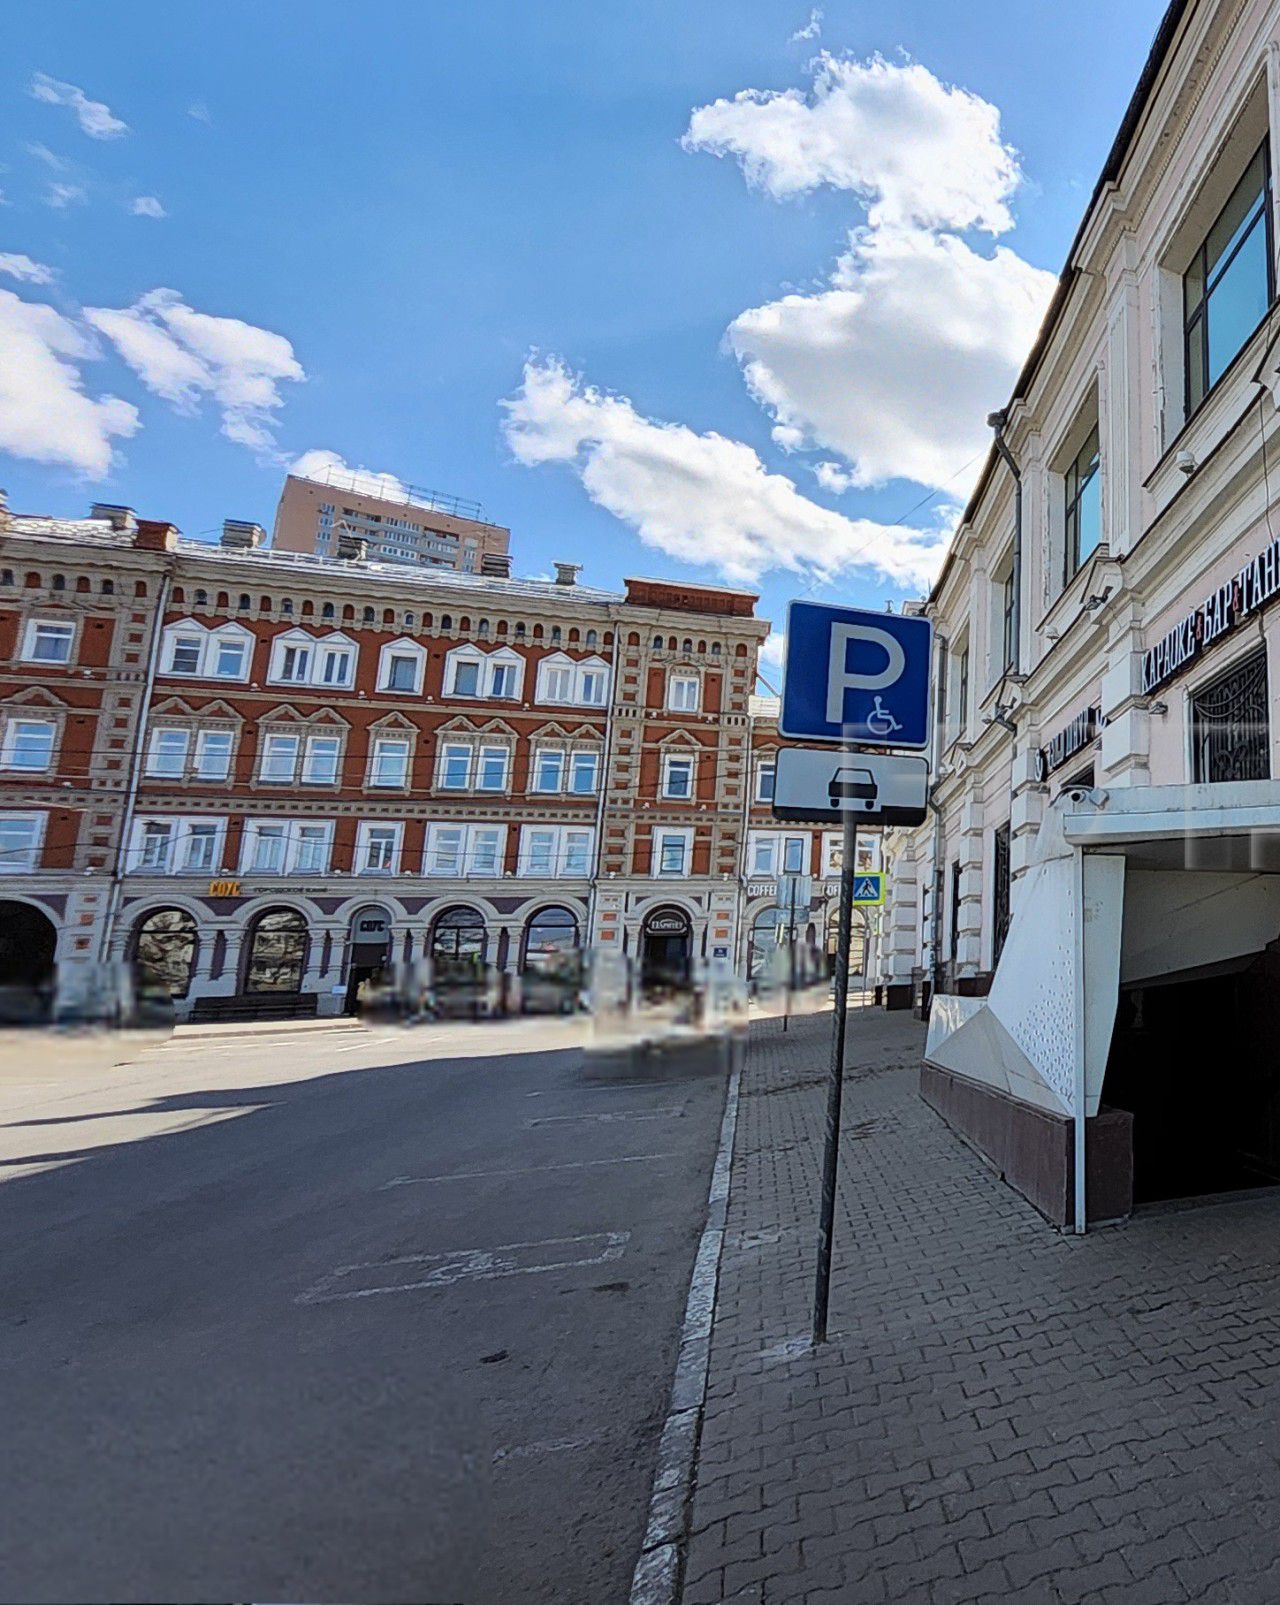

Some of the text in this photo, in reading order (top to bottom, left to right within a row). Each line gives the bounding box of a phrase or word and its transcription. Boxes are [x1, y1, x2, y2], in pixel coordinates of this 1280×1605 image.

[826, 621, 906, 724] P
[1141, 610, 1196, 695] КАРАОКЕ
[1202, 579, 1234, 646] БАР
